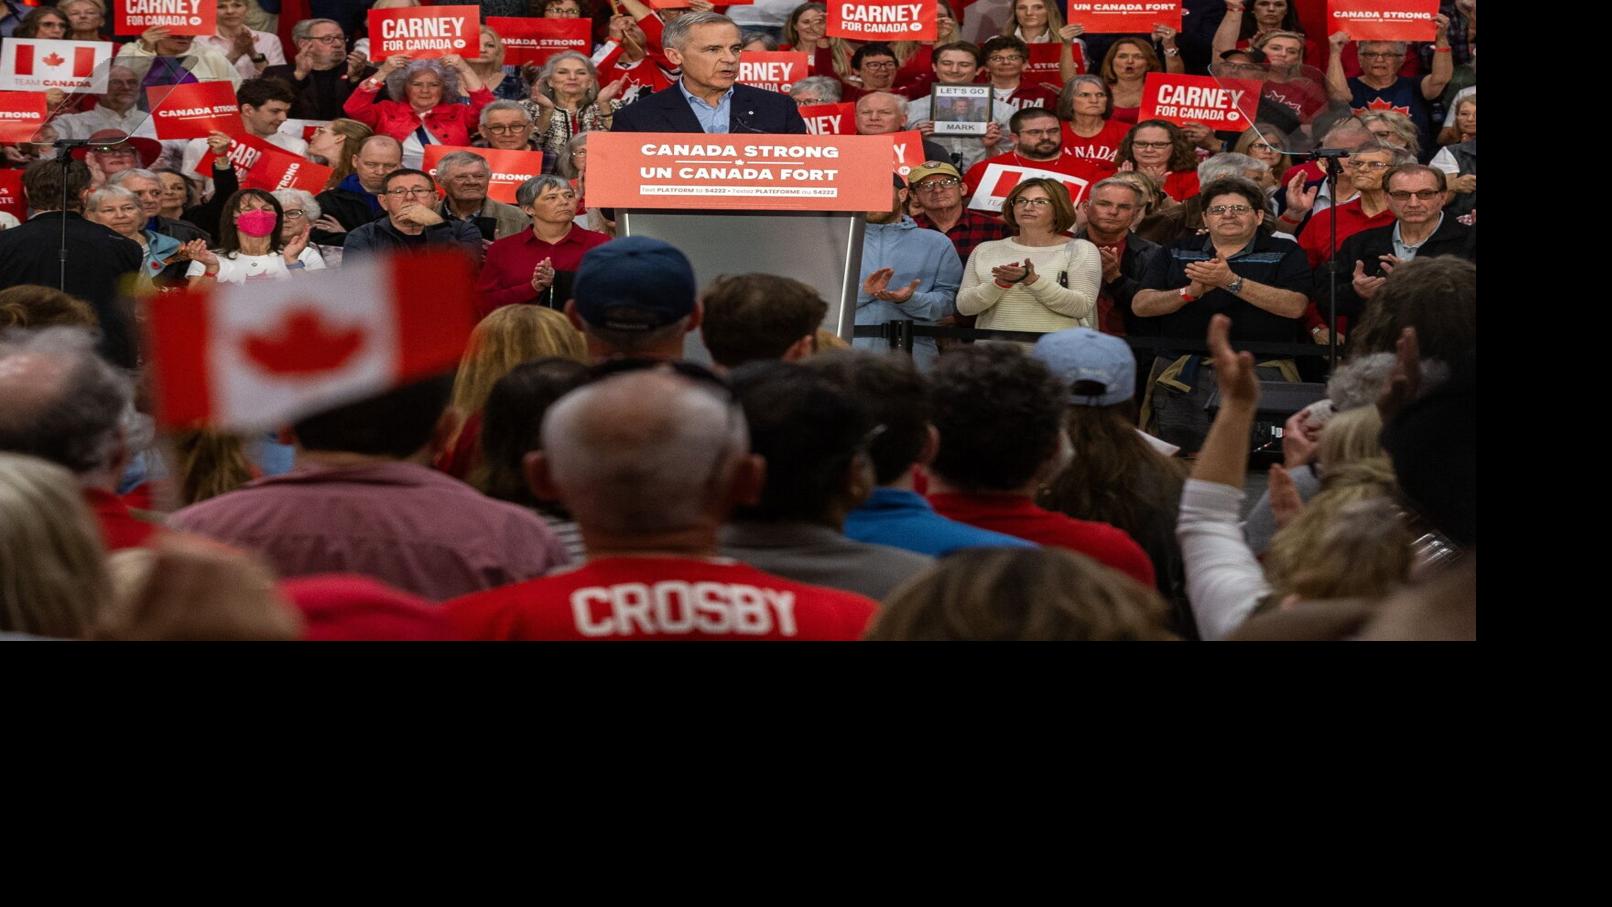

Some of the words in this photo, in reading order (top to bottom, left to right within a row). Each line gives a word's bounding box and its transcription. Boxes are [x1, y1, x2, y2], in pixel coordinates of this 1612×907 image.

[126, 0, 200, 14] CARNEY
[842, 3, 922, 22] CARNEY
[1073, 3, 1091, 11] UN
[1093, 3, 1143, 11] CANADA
[1145, 3, 1176, 11] FORT
[126, 15, 143, 26] FOR
[145, 15, 188, 26] CANADA
[1383, 11, 1431, 19] STRONG
[382, 17, 464, 39] CARNEY
[842, 21, 862, 31] FOR
[864, 23, 908, 32] CANADA
[383, 40, 403, 51] FOR
[406, 39, 451, 50] CANADA
[540, 38, 585, 46] STRONG
[940, 87, 967, 95] LET'S
[1158, 84, 1245, 109] CARNEY
[158, 107, 212, 118] CANADA
[1155, 105, 1177, 117] FOR
[1179, 107, 1224, 120] CANADA
[641, 143, 738, 157] CANADA
[744, 145, 839, 158] STRONG
[640, 167, 672, 179] UN
[679, 168, 774, 180] CANADA
[780, 169, 838, 181] FORT
[569, 580, 798, 637] CROSBY
